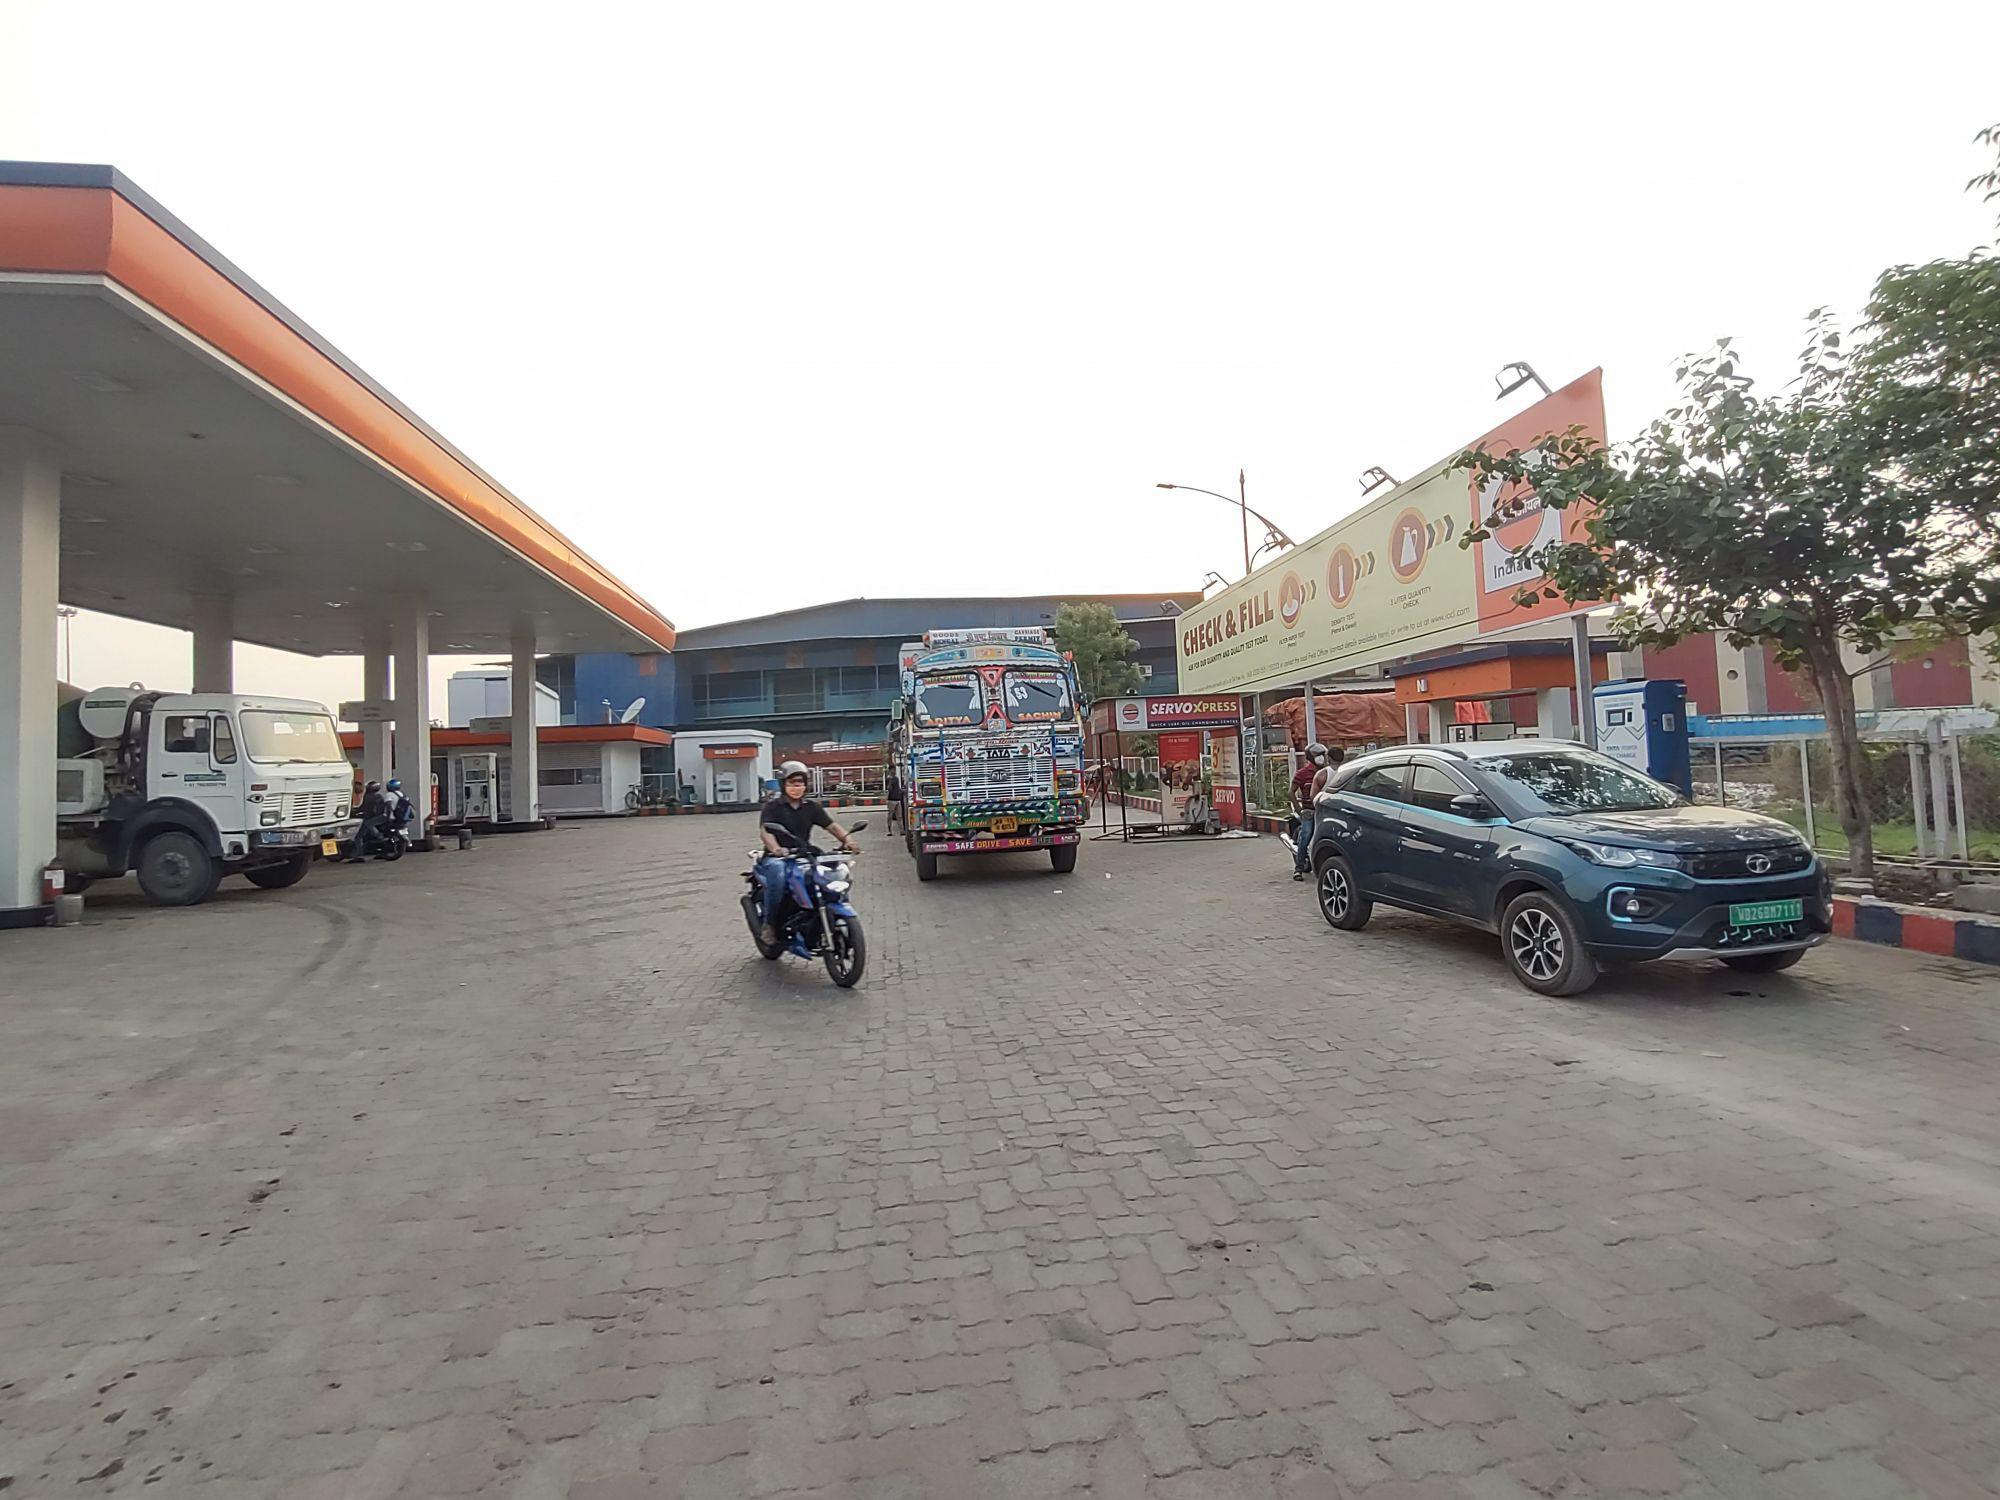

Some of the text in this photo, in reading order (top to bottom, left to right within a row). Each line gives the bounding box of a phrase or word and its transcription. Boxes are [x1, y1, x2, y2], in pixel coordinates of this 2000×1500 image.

[1394, 594, 1407, 605] LITER
[1408, 586, 1432, 599] QUANTITY
[1402, 599, 1420, 610] CHECK
[1183, 590, 1274, 657] CHECK & FILL
[1423, 618, 1430, 626] at
[1207, 653, 1222, 665] QUANTITY
[1222, 650, 1230, 659] AND
[1231, 643, 1245, 656] QUALITY
[1245, 640, 1254, 649] TEST
[1014, 686, 1028, 700] 53
[927, 715, 972, 725] ADITYA
[1017, 711, 1062, 721] SACHIN
[985, 749, 1011, 759] TATA
[1215, 788, 1236, 804] SERVO
[955, 842, 975, 850] SAFE
[976, 840, 1001, 848] DRIVE
[1008, 839, 1032, 847] SAVE
